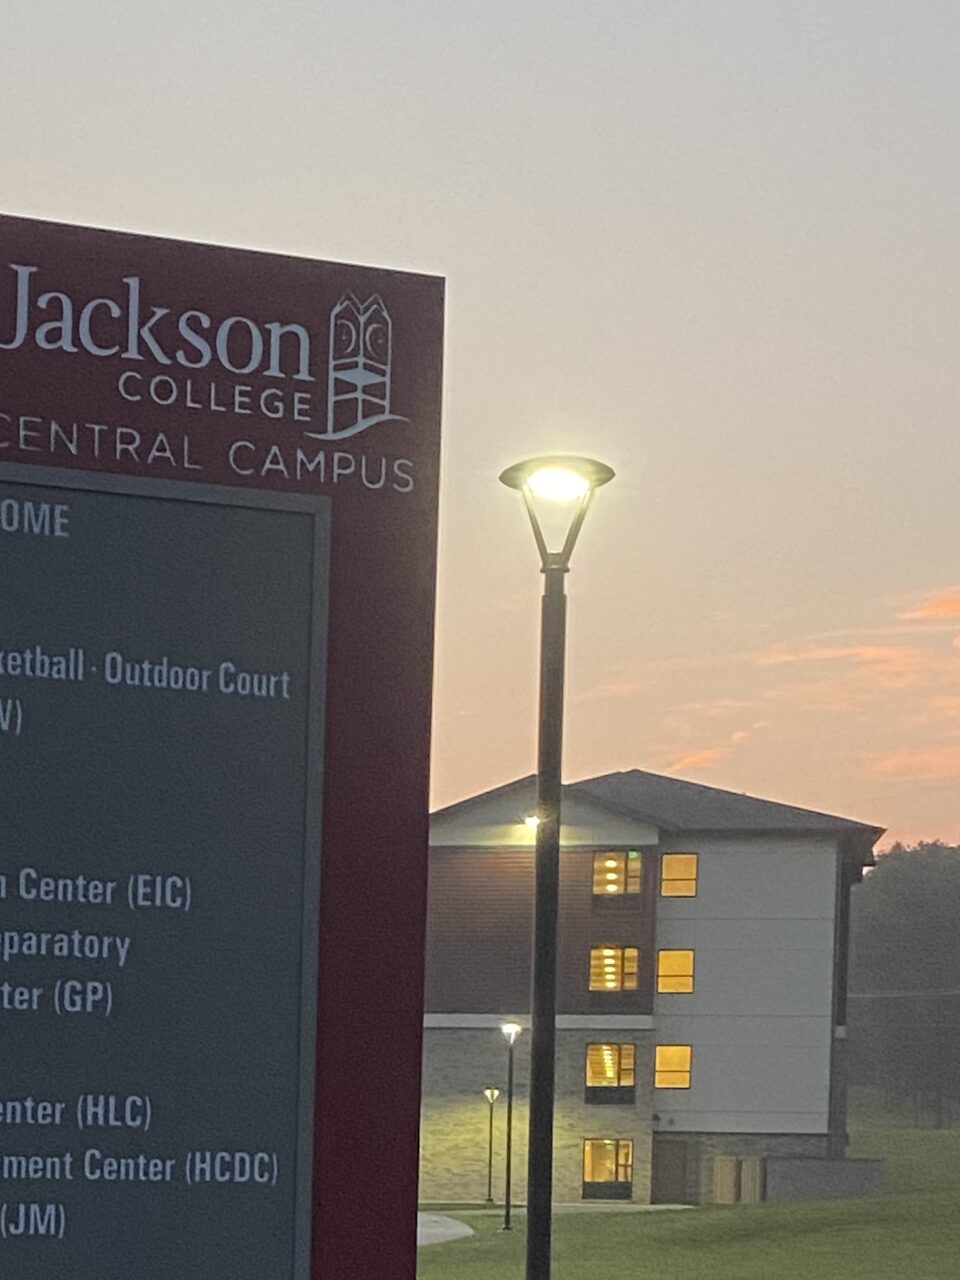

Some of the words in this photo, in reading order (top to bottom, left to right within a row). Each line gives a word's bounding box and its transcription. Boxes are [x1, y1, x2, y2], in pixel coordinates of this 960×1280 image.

[118, 369, 316, 423] COLLEGE
[228, 440, 414, 493] CAMPUS
[104, 651, 212, 692] Outdoor
[218, 661, 290, 699] Court
[19, 867, 117, 904] Center
[127, 874, 191, 911] (EIC)
[54, 980, 113, 1016] (GP)
[77, 1094, 151, 1131] (HLC)
[84, 1148, 176, 1181] Center
[185, 1151, 278, 1186] (HCDC)
[0, 1203, 65, 1239] (JM)
